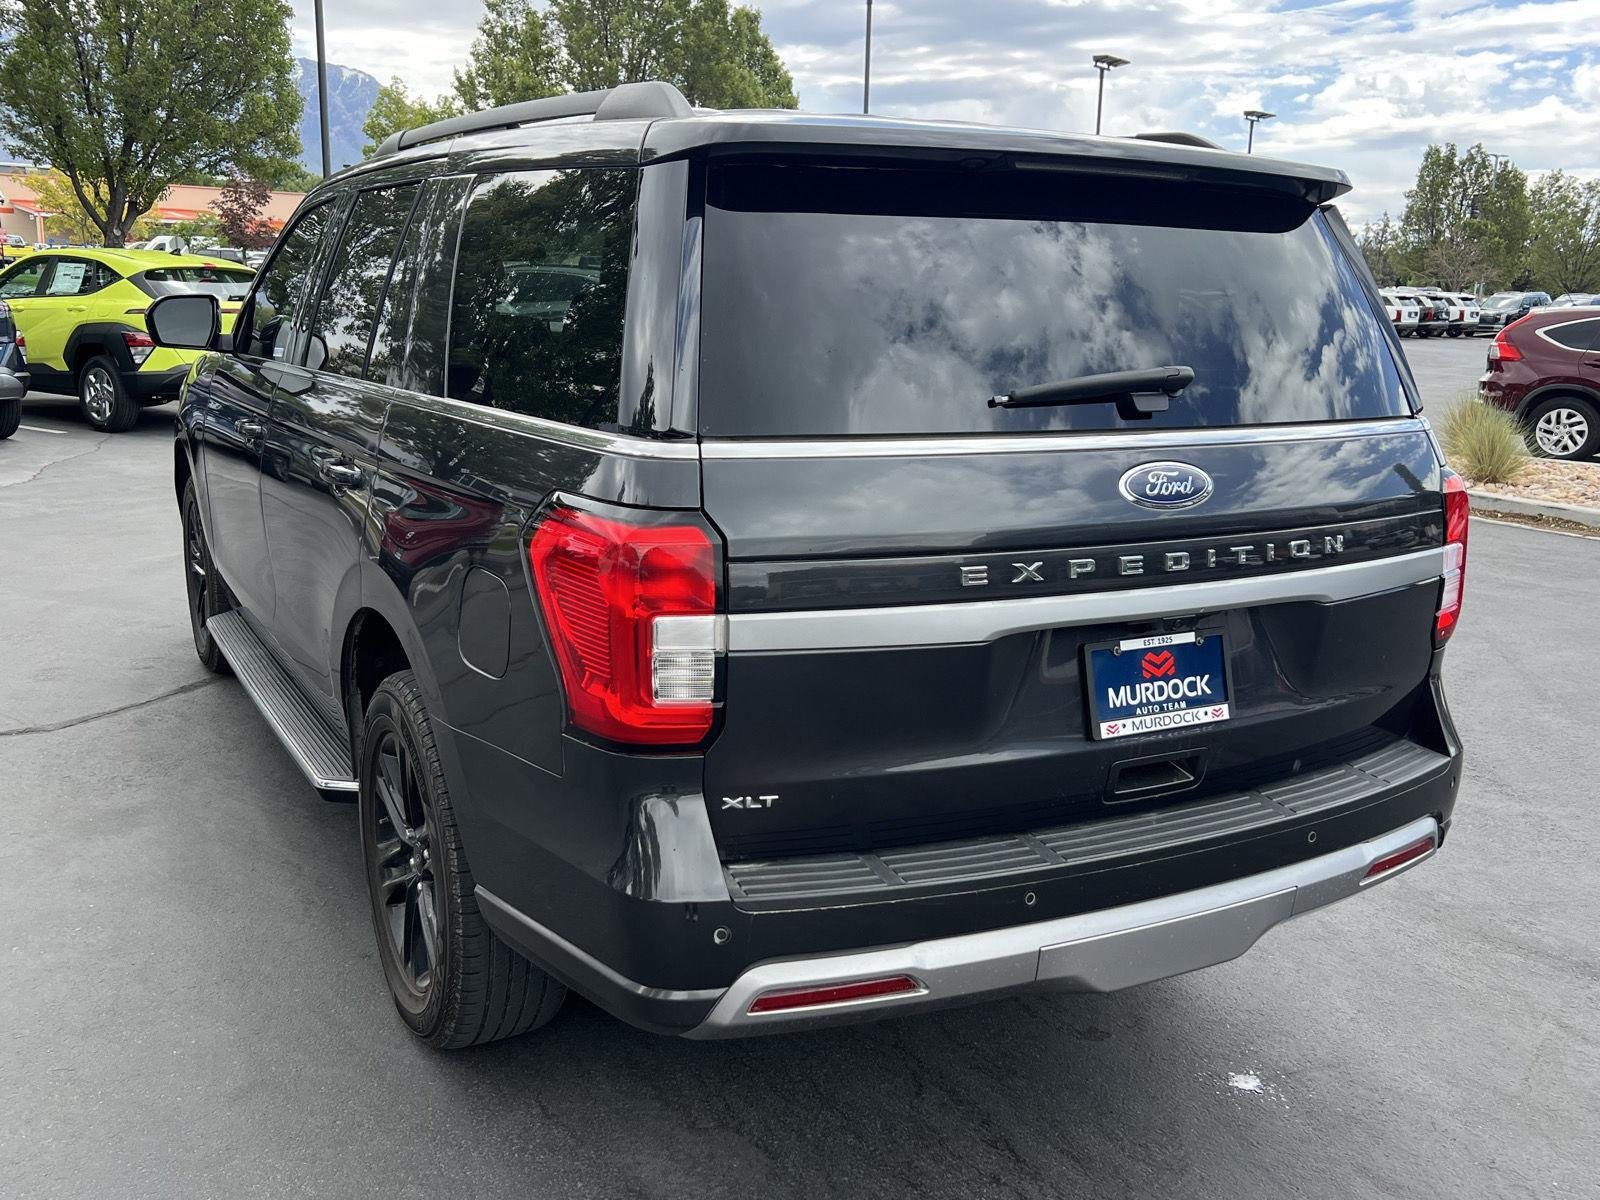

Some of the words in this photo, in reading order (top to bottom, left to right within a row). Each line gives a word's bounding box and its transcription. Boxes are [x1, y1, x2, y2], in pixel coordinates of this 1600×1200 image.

[1145, 471, 1194, 496] Ford
[960, 534, 1344, 587] EXPEDITION
[1143, 638, 1157, 646] EST.
[1157, 636, 1173, 645] 1925
[1107, 674, 1212, 708] MURDOCK
[1136, 705, 1160, 715] AUTO
[1163, 701, 1187, 711] TEAM
[1132, 711, 1201, 731] MURDOCK
[721, 795, 779, 809] XLT
